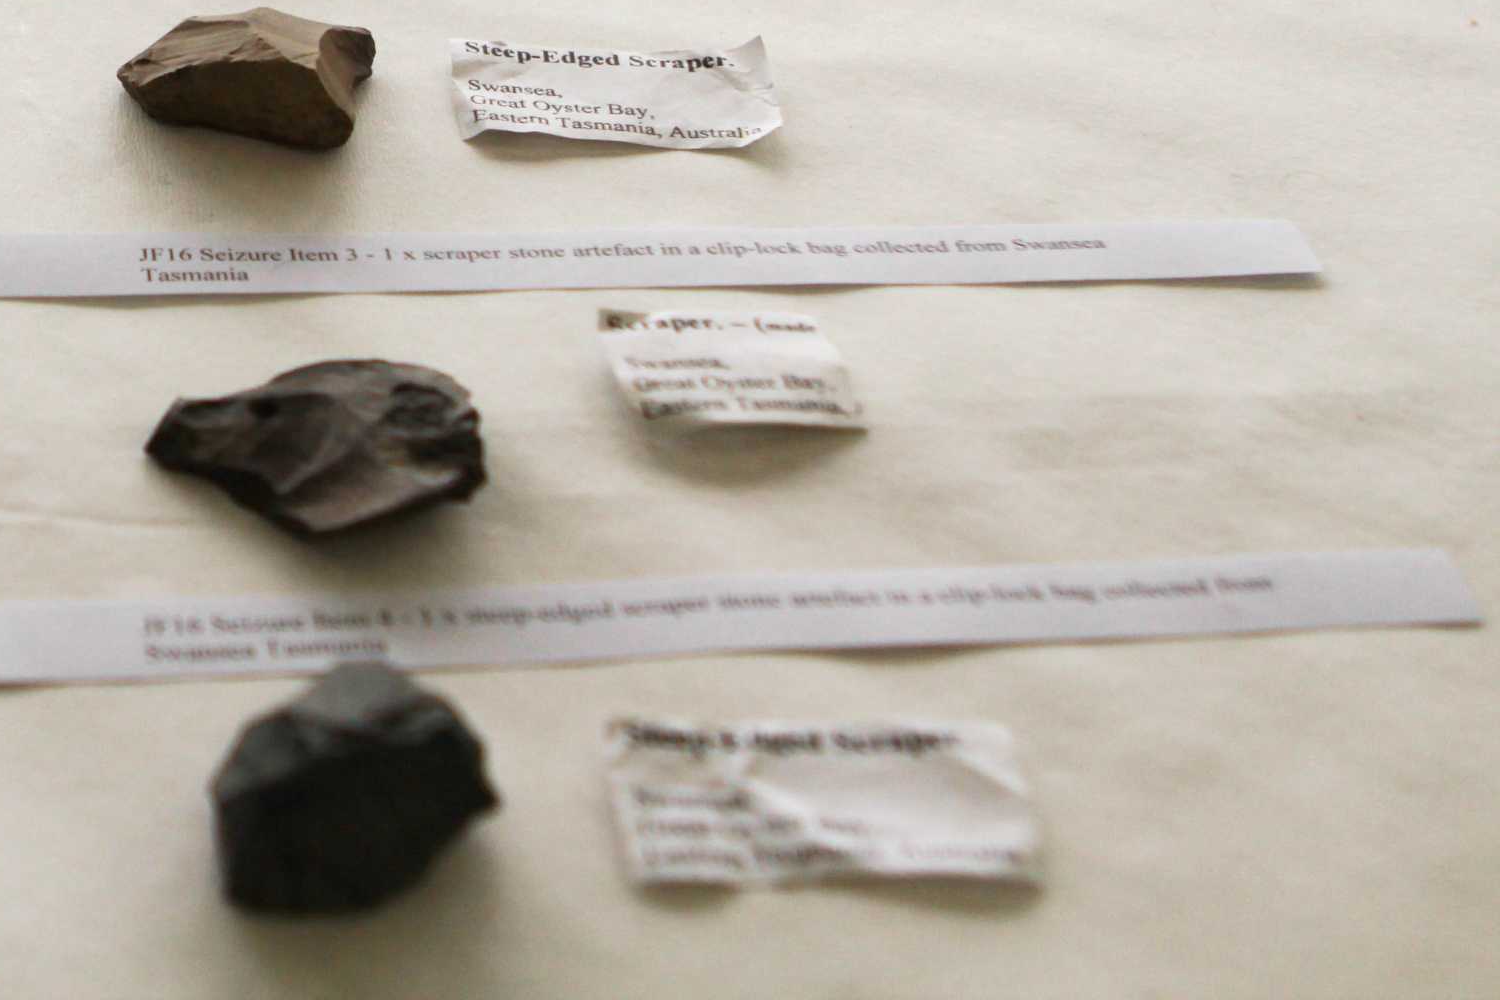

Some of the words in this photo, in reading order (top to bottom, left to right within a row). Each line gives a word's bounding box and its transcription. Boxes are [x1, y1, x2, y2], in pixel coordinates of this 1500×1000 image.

[465, 41, 620, 69] Steep-Edged
[629, 53, 735, 72] Scraper.
[468, 79, 563, 98] Swansea,
[470, 94, 526, 110] Great
[533, 100, 601, 117] Oyster
[608, 103, 655, 120] Bay,
[473, 109, 550, 126] Eastern
[555, 116, 662, 139] Tasmania,
[140, 247, 193, 262] JF16
[200, 247, 281, 262] Seizure
[289, 247, 339, 262] Item
[423, 248, 500, 263] scraper
[508, 246, 565, 259] stone
[573, 243, 655, 258] artefact
[660, 243, 681, 256] in
[706, 241, 801, 258] clip-lock
[806, 241, 849, 257] bag
[854, 239, 949, 255] collected
[955, 239, 1006, 252] from
[1011, 237, 1106, 251] Swansea
[141, 267, 249, 283] Tasmania
